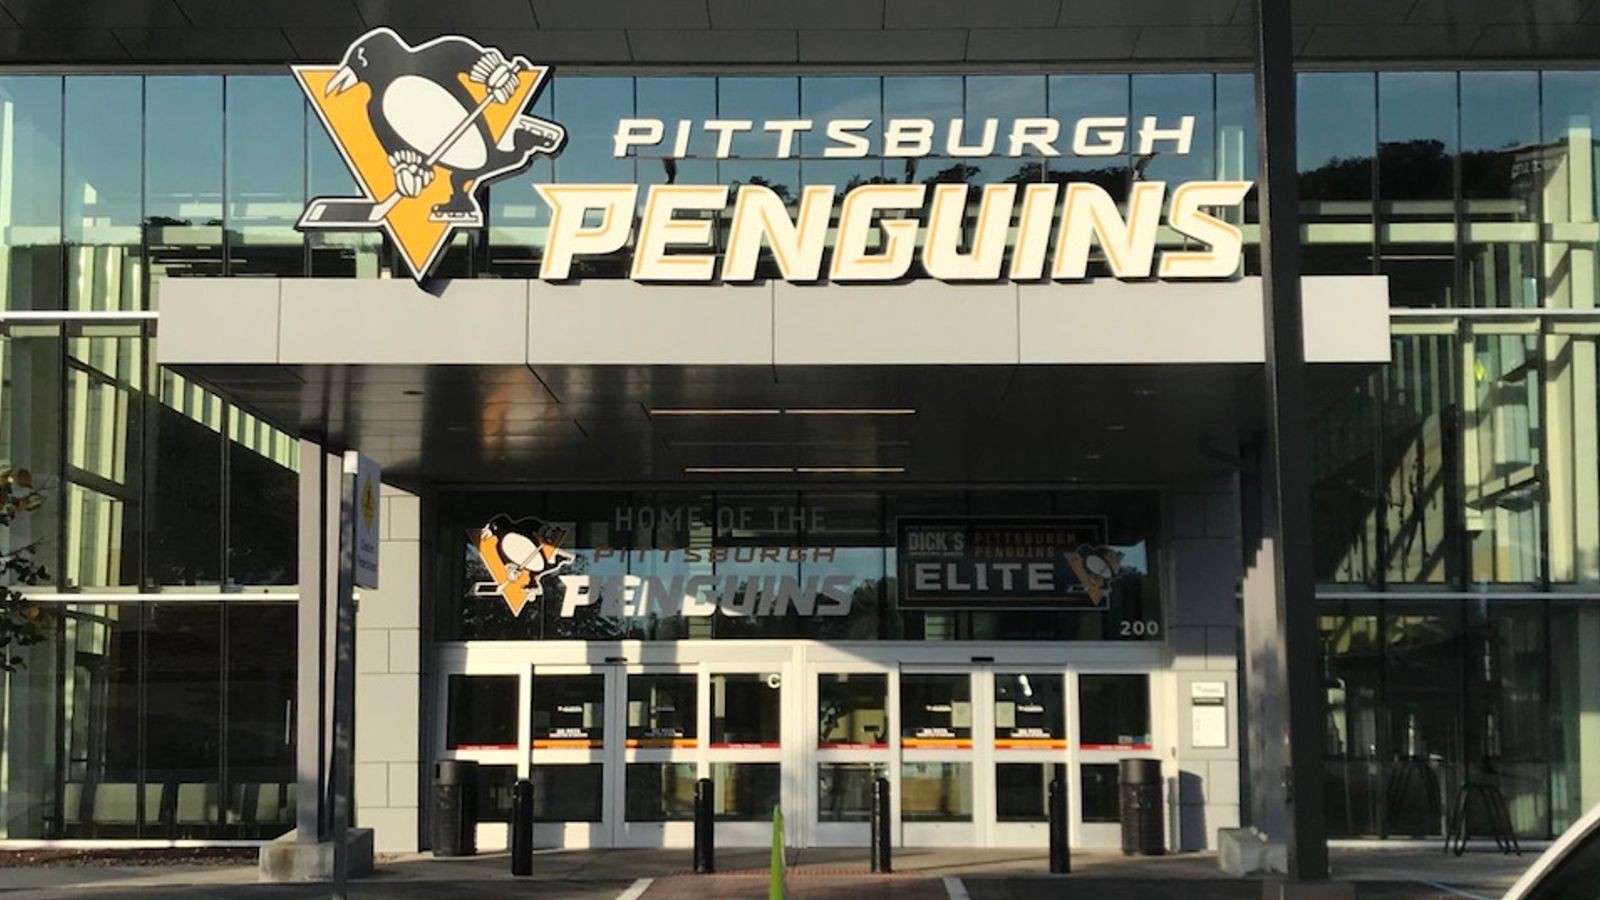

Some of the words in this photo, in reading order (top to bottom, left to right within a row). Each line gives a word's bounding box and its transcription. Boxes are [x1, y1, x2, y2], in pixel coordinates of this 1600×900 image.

[614, 115, 1195, 158] PITTSBURGH
[532, 180, 1254, 284] PENGUINS
[615, 506, 701, 532] HOME
[716, 506, 754, 531] OF
[769, 506, 826, 531] THE
[907, 531, 965, 551] DICK'S
[974, 532, 1077, 546] PITTSBURGH
[593, 546, 837, 563] PITTSBURGH
[974, 546, 1056, 558] PENGUINS
[914, 563, 1056, 591] ELITE
[559, 574, 857, 617] PENGUINS
[1119, 620, 1160, 636] 200
